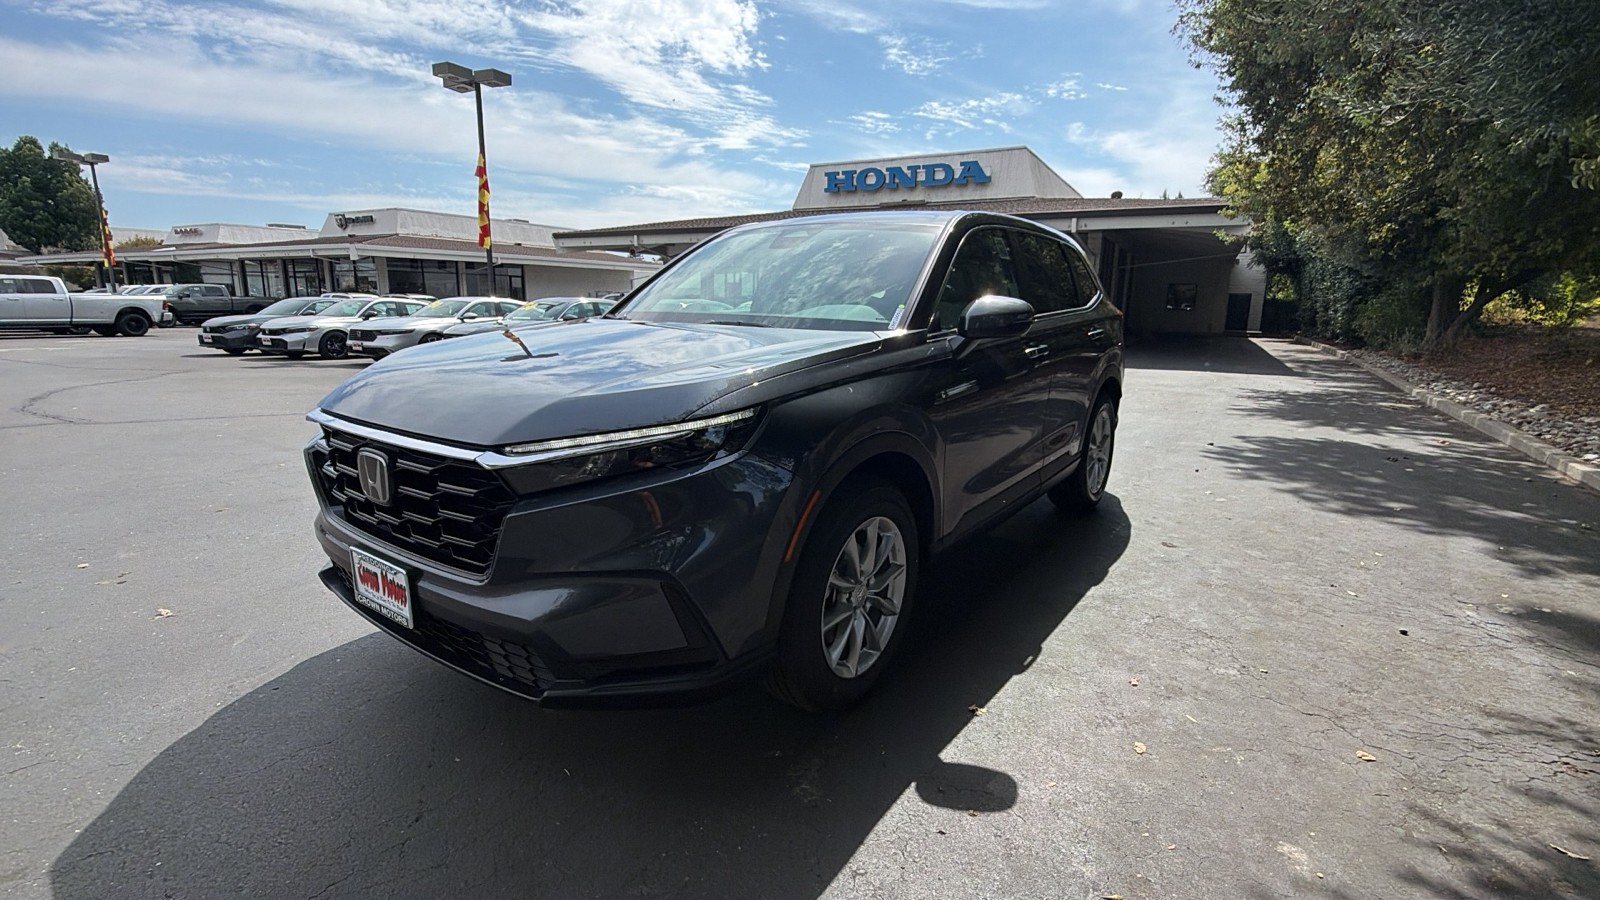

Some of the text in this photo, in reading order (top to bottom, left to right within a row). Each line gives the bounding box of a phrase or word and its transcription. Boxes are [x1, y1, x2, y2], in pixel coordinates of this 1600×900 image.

[824, 160, 992, 193] HONDA
[358, 595, 381, 611] CROWN
[381, 604, 408, 626] MOTORS
